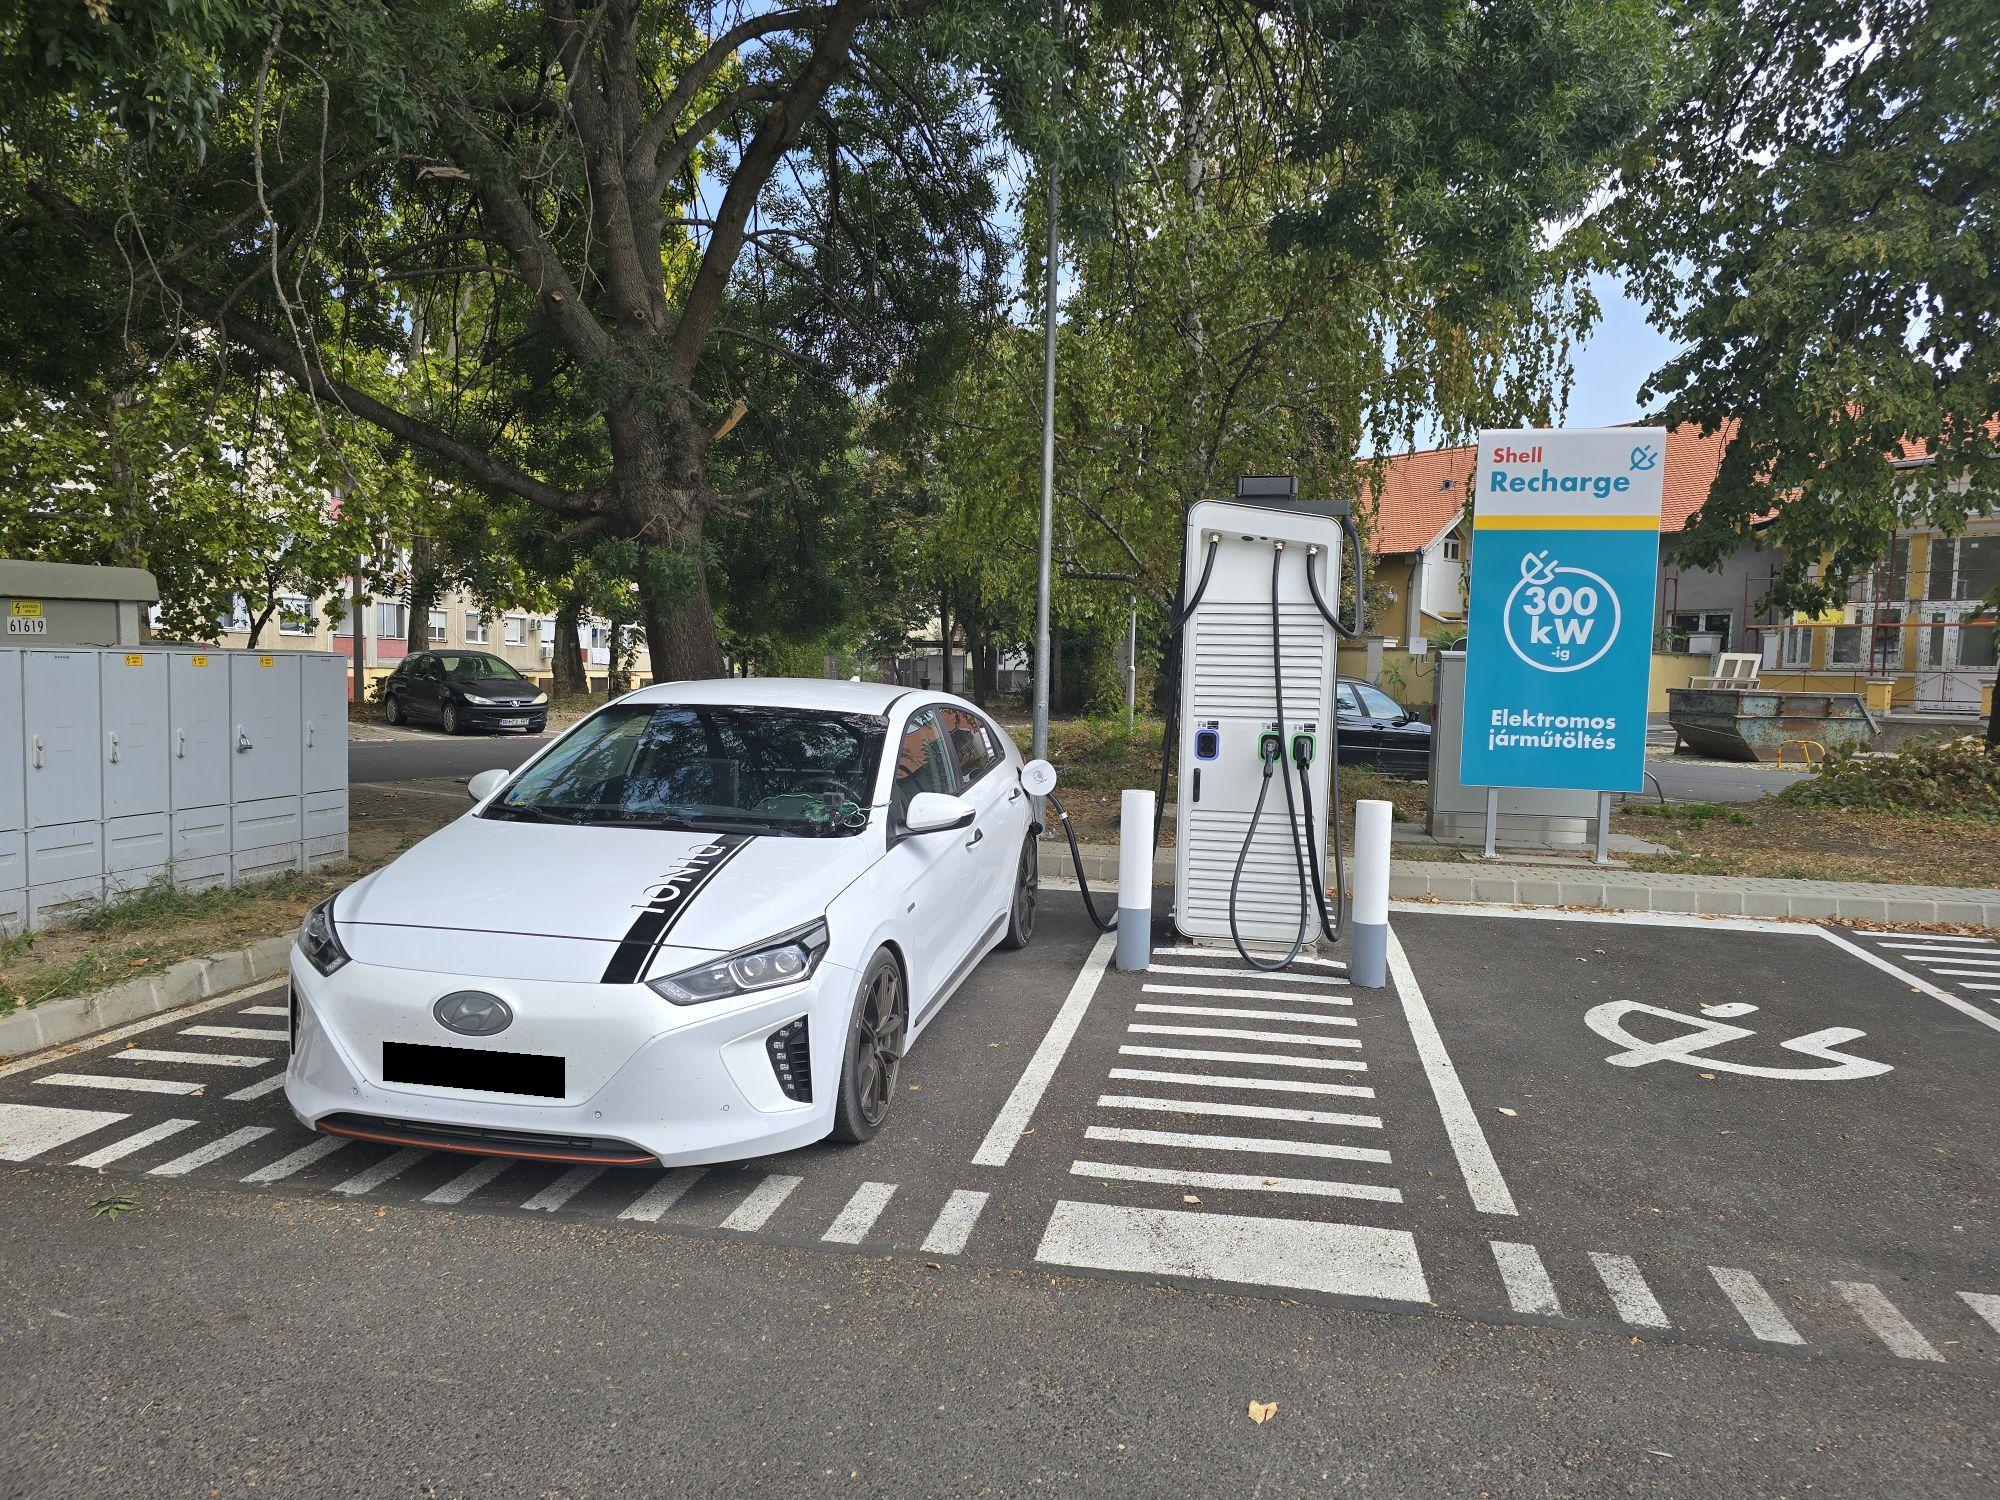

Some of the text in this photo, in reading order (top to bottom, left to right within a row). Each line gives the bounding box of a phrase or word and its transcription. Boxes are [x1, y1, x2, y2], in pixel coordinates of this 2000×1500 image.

[1493, 446, 1543, 464] Shell
[1490, 468, 1631, 499] Recharge
[1523, 586, 1598, 616] 300
[10, 619, 44, 632] 61619
[1530, 615, 1595, 645] kW
[1551, 646, 1570, 661] -ig
[1491, 708, 1616, 730] Elektromos
[1488, 728, 1616, 751] járműtöltés
[631, 843, 727, 914] IONIQ
